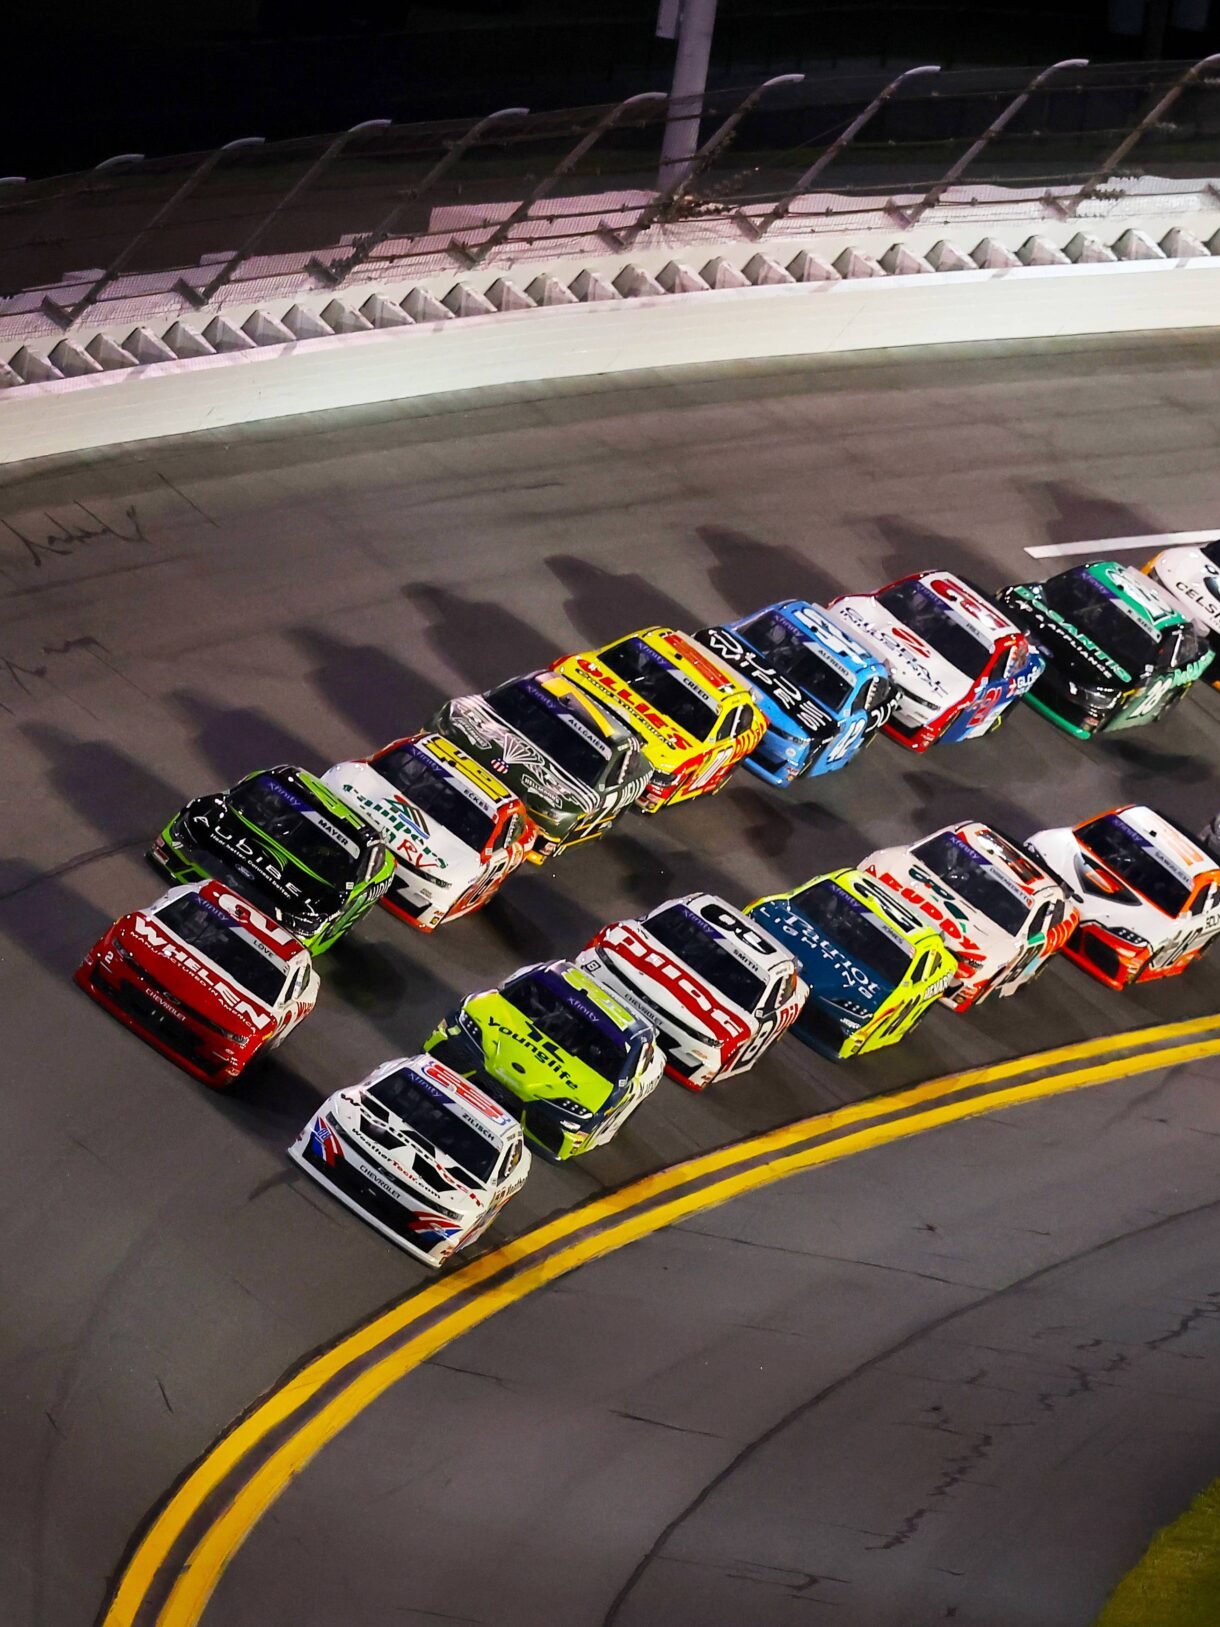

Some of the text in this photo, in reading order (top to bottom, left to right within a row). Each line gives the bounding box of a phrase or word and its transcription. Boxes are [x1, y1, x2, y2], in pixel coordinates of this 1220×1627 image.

[1081, 572, 1114, 595] xfinity
[773, 614, 803, 638] xfinity
[637, 642, 667, 665] xfinity
[818, 649, 849, 677] ALFREDO
[1048, 623, 1113, 679] APPLIANCE
[682, 677, 710, 700] CREED
[708, 630, 832, 726] DUDE
[710, 635, 825, 731] WIPES
[526, 684, 557, 710] xfinity
[577, 658, 693, 750] OLLIE'S
[567, 718, 606, 752] ALLGAIER
[412, 749, 442, 772] xfinity
[268, 781, 302, 807] xfinity
[462, 788, 490, 812] ECKES
[318, 819, 349, 846] MAYER
[1112, 820, 1143, 842] xfinity
[209, 833, 223, 843] Hear
[247, 858, 272, 882] Connect
[397, 839, 439, 869] RV
[950, 837, 980, 859] xfinity
[193, 815, 316, 916] AUDIBEL
[196, 896, 231, 922] xfinity
[830, 884, 859, 907] xfinity
[683, 910, 714, 933] xfinity
[882, 925, 903, 944] JONES
[104, 951, 114, 964] 2
[252, 938, 274, 959] LOVE
[733, 949, 759, 972] SMITH
[760, 906, 874, 999] LIGHTING
[784, 914, 881, 994] Patriot
[134, 915, 271, 1030] WHELEN
[586, 960, 601, 971] 8
[130, 931, 207, 990] MANUFACTURED
[208, 986, 218, 996] IN
[218, 998, 257, 1033] AMERICA
[605, 924, 744, 1038] pilot
[145, 987, 187, 1023] CHEVROLET
[567, 996, 600, 1023] xfinity
[624, 992, 663, 1026] CHEVROLET
[487, 1016, 578, 1090] younglife
[408, 1071, 443, 1099] xfinity
[461, 1112, 495, 1142] ZILISCH
[340, 1092, 485, 1208] WeatherTech
[352, 1127, 442, 1200] WeatherTech.com
[359, 1164, 402, 1200] CHEVROLET
